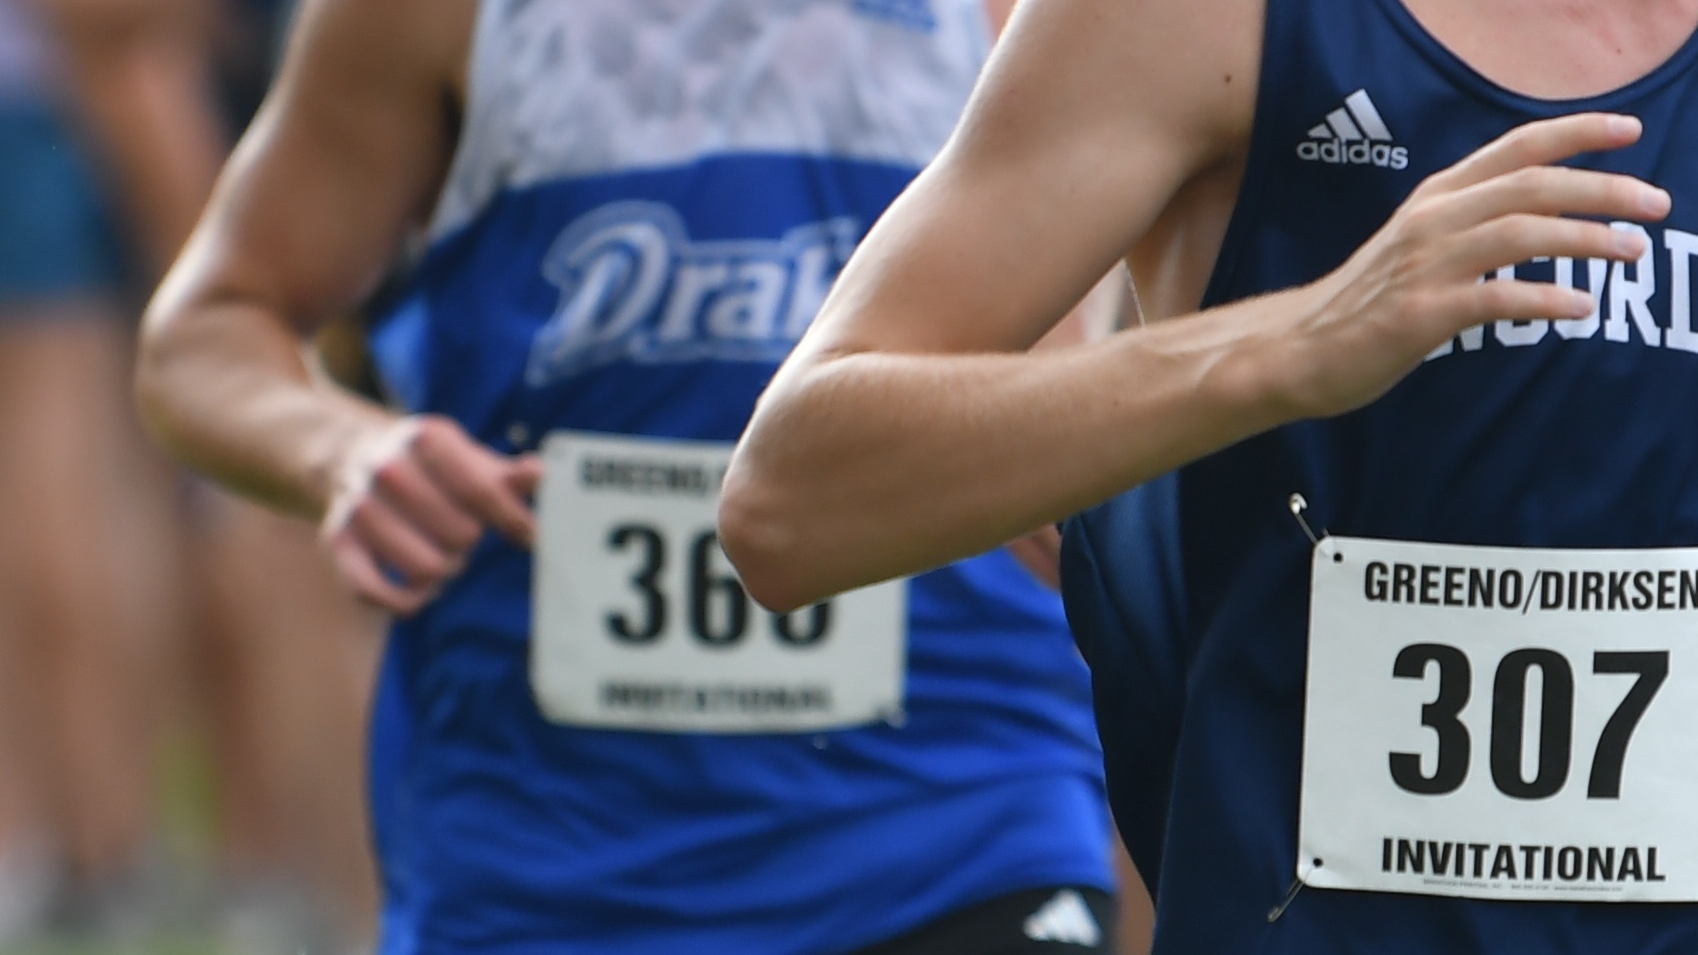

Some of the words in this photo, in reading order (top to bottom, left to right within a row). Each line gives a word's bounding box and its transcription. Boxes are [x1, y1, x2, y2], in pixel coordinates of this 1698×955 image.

[1296, 137, 1409, 170] adidas
[1388, 642, 1670, 800] 307
[1381, 837, 1667, 883] INVITATIONAL
